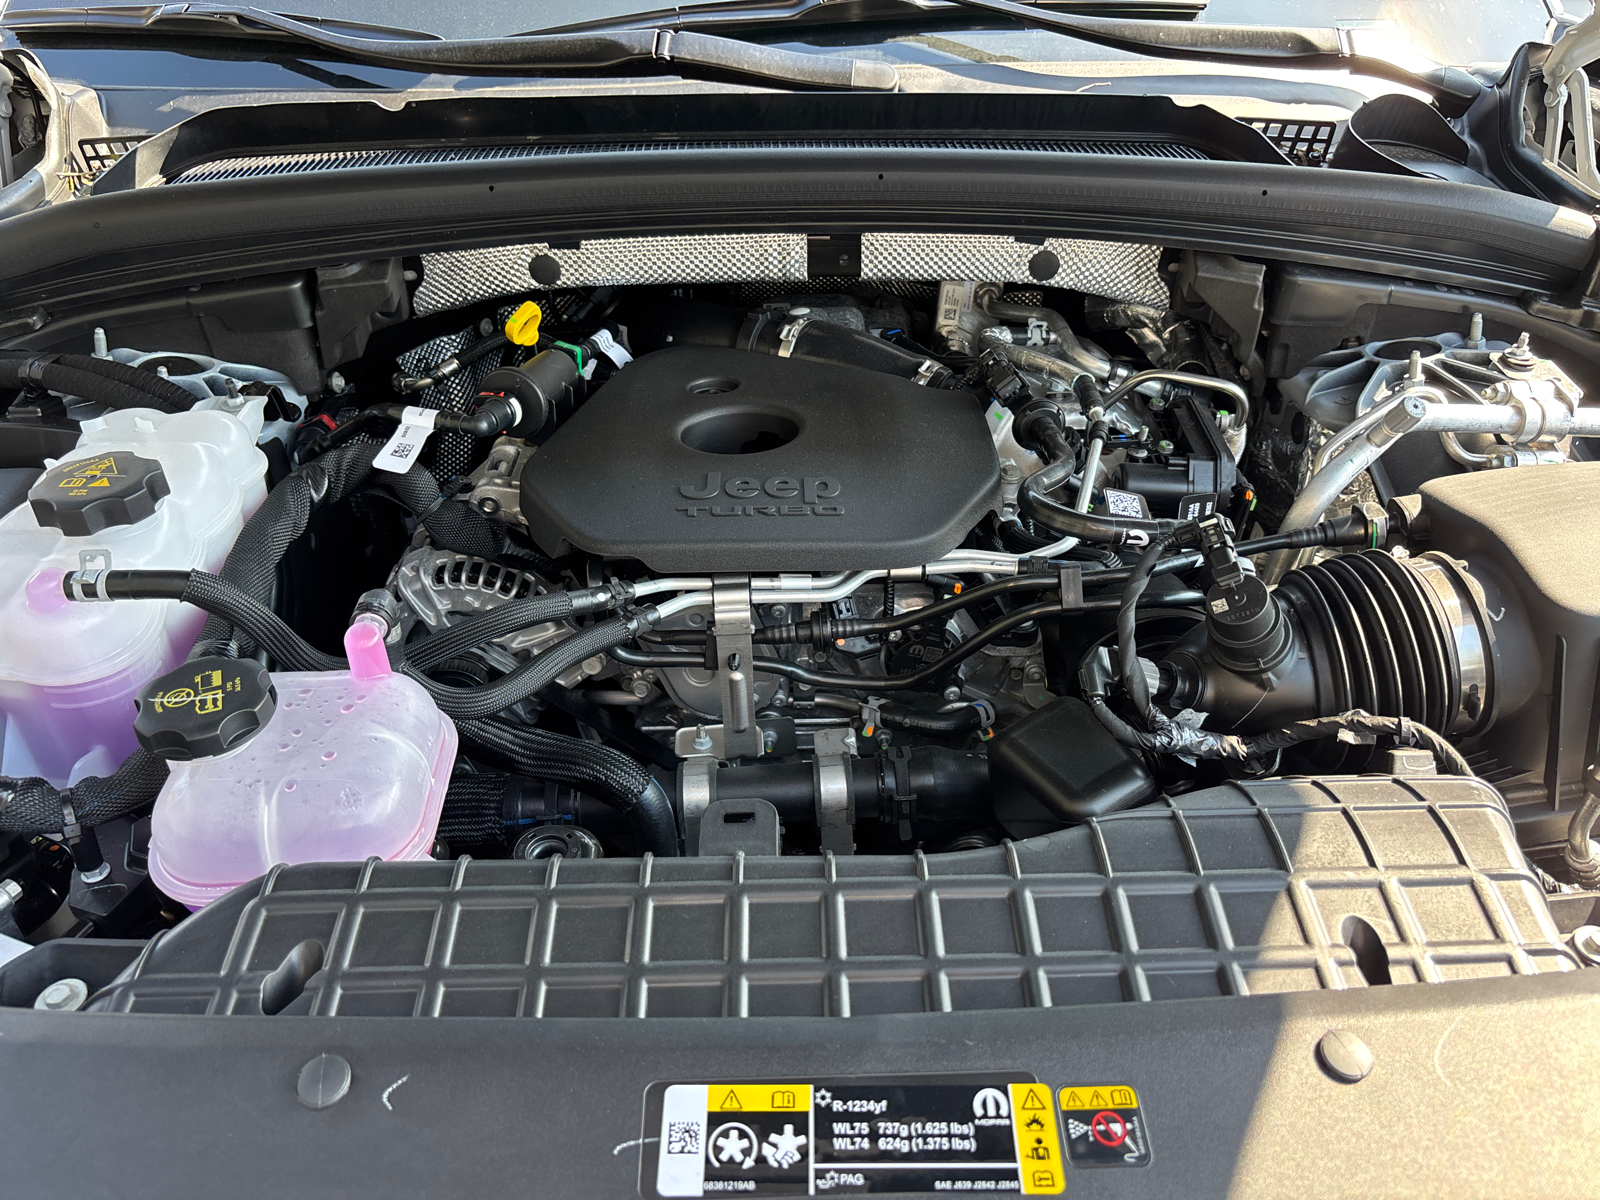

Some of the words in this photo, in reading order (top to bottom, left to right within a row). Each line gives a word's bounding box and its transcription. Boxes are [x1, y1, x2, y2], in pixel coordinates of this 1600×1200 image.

[679, 471, 841, 504] Jeep
[676, 505, 845, 517] TURBO
[832, 1100, 888, 1115] R-1234yf
[832, 1122, 870, 1135] WL75
[877, 1122, 909, 1138] 737g
[910, 1122, 948, 1138] (1.625
[950, 1122, 976, 1137] lbs)
[832, 1137, 871, 1150] WL74
[877, 1137, 910, 1153] 624g
[911, 1137, 950, 1152] (1.375
[951, 1137, 978, 1153] lbs)
[840, 1173, 866, 1186] PAG
[934, 1180, 952, 1190] SAE
